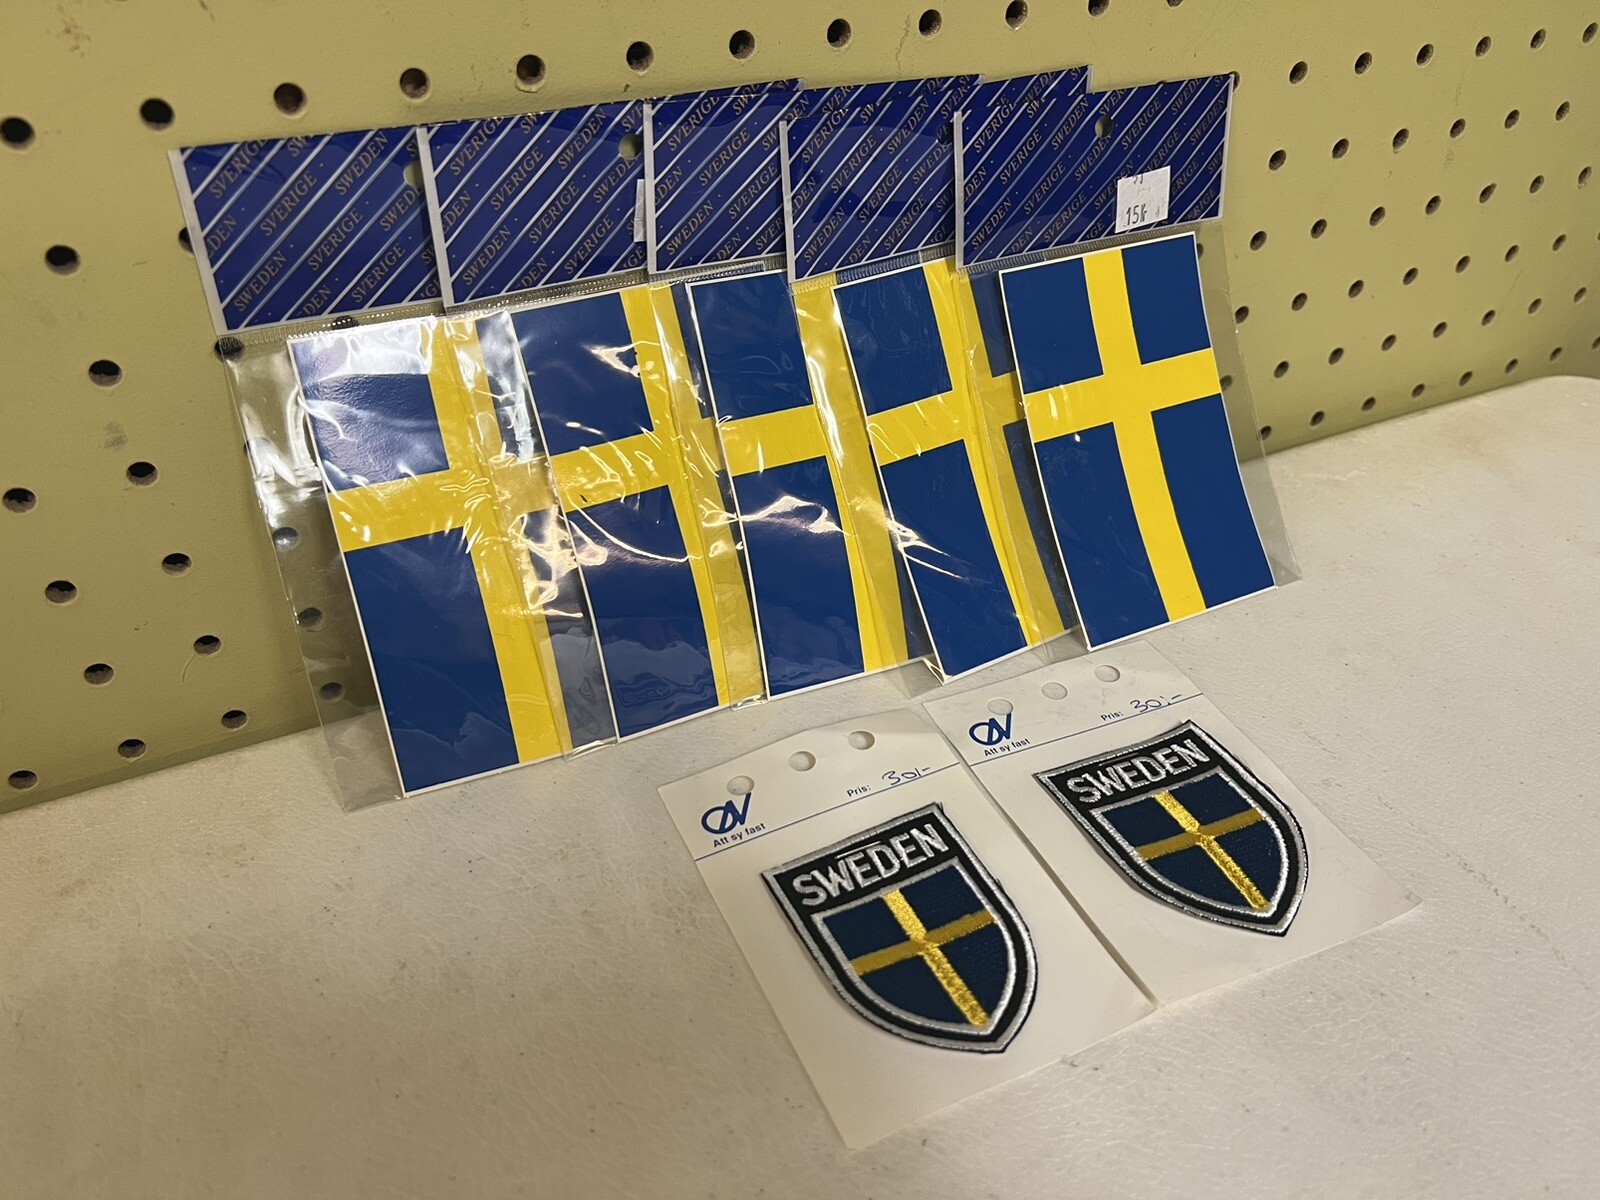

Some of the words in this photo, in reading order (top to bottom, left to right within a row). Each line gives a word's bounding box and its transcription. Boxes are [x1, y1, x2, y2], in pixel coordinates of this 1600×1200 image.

[1189, 97, 1225, 146] SWEDEN
[491, 148, 544, 211] SVERIGE
[699, 128, 750, 187] SVERIGE
[804, 207, 845, 263] SWEDEN
[887, 100, 930, 155] SWEDEN
[831, 134, 877, 194] SVERIGE
[972, 198, 1013, 250] SWEDEN
[1052, 97, 1089, 151] SWEDEN
[1000, 130, 1042, 185] SVERIGE
[1044, 192, 1087, 243] SVERIGE
[1122, 100, 1162, 150] SVERIGE
[1143, 129, 1180, 175] VERIGE
[260, 171, 317, 237] SVERIGE
[462, 226, 511, 286] SWEDEN
[558, 108, 607, 169] SWEDEN
[529, 183, 580, 244] SVERIGE
[728, 162, 778, 220] SVERIGE
[859, 165, 902, 223] SVERIGE
[1024, 161, 1066, 215] SVERIGE
[234, 250, 287, 312] SWEDEN
[334, 131, 389, 196] SWEDEN
[308, 208, 364, 271] SVERIGE
[564, 217, 614, 274] SVERIGE
[667, 201, 714, 255] SWEDEN
[884, 195, 927, 250] SVERIGE
[352, 243, 405, 303] SVERIGE
[1100, 711, 1123, 722] Pris:
[984, 746, 998, 757] Att
[999, 743, 1010, 753] sy
[1010, 738, 1030, 749] fast
[1066, 738, 1210, 804] SWEDEN
[846, 783, 872, 798] Pris:
[713, 833, 729, 848] Att
[730, 828, 744, 843] sy
[744, 822, 766, 837] fast
[792, 823, 950, 907] SWEDEN
